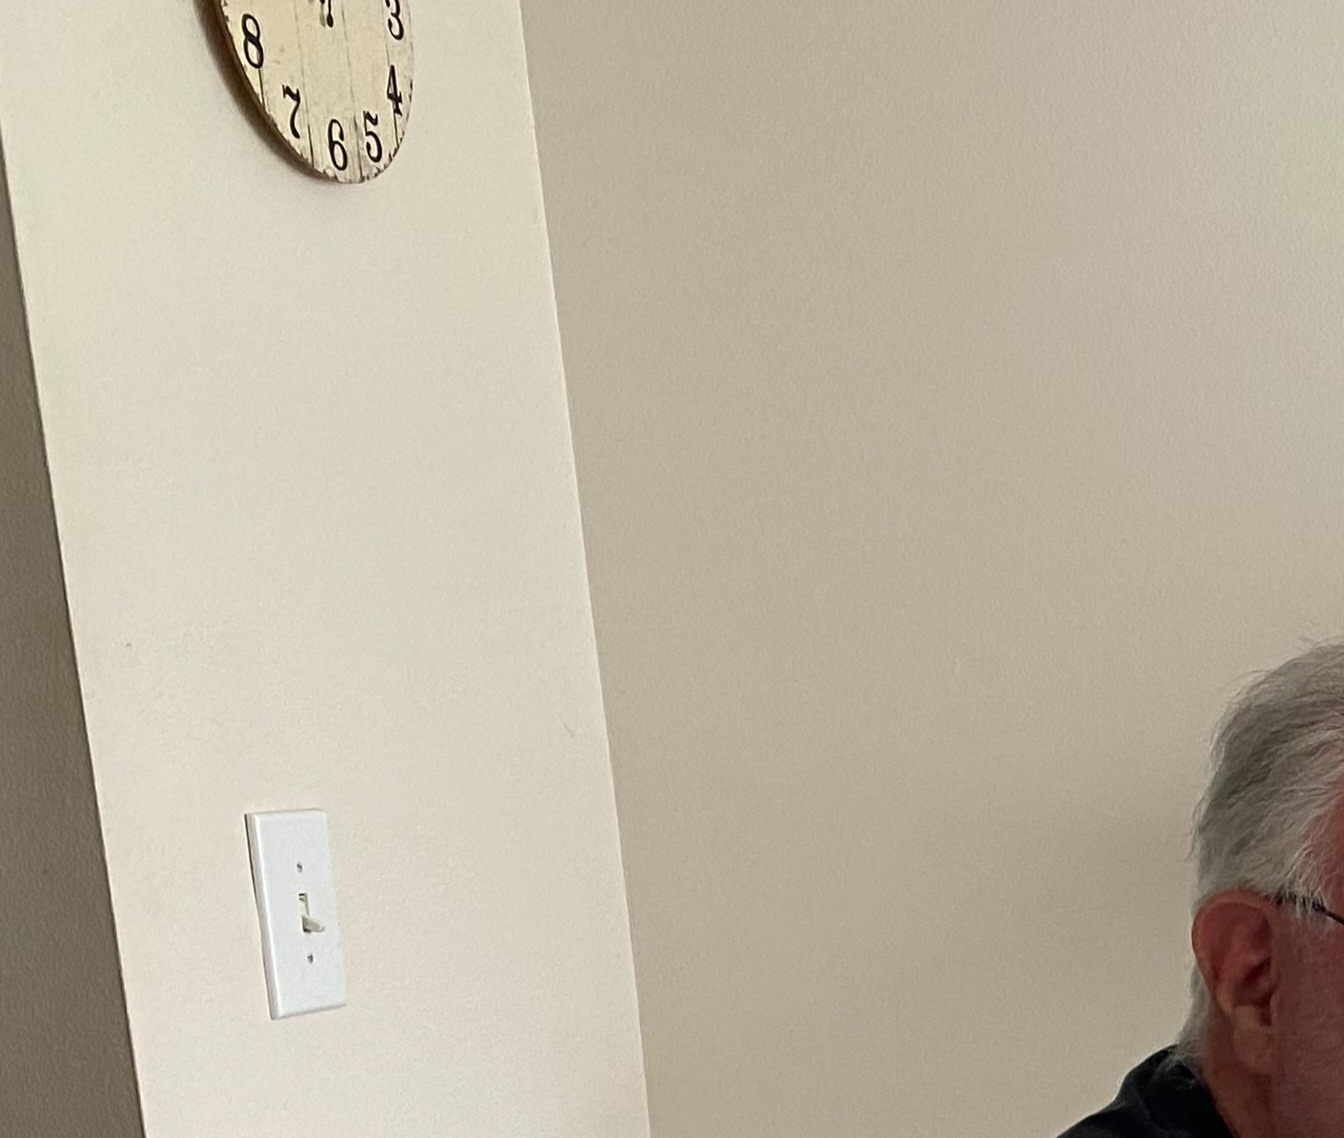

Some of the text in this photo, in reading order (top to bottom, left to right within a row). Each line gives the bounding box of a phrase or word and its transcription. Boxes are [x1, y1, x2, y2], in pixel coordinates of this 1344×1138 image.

[242, 13, 264, 69] 8
[282, 84, 301, 139] 7
[387, 64, 403, 116] 4
[328, 118, 348, 171] 6
[363, 110, 382, 163] 5
